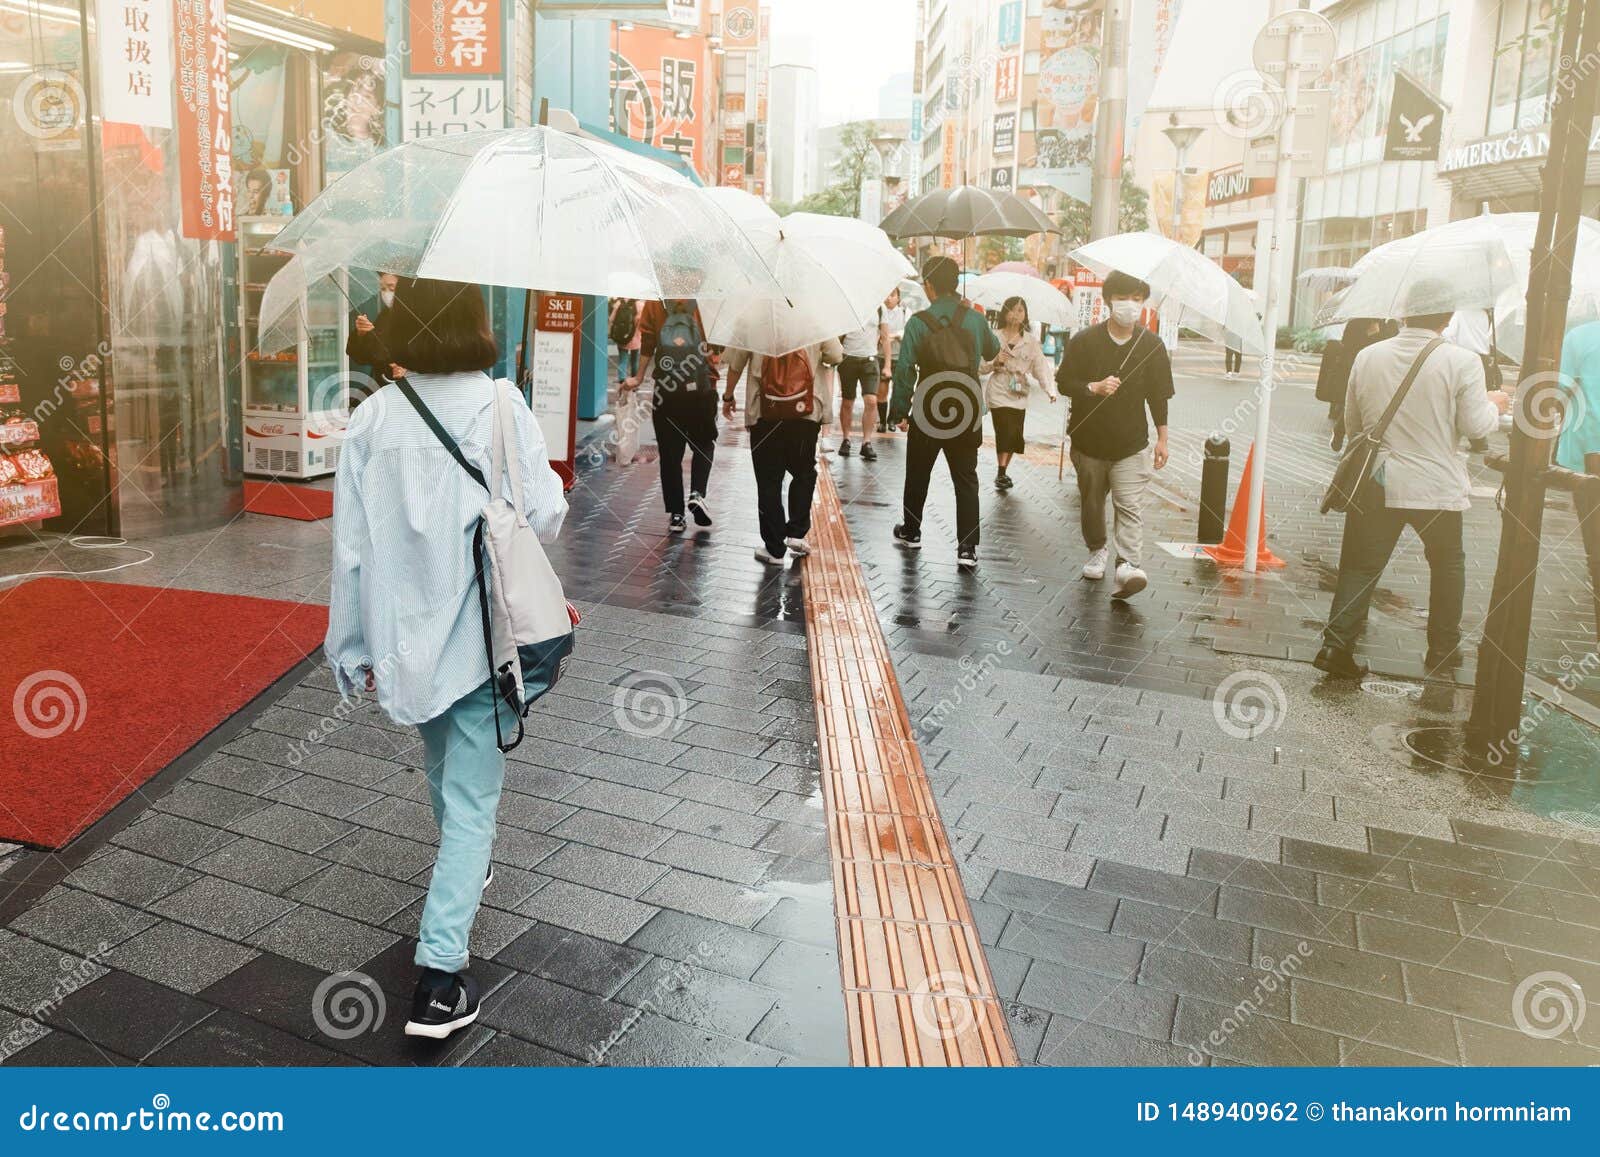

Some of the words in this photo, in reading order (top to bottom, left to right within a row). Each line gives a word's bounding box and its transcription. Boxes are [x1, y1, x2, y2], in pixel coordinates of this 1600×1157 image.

[124, 0, 154, 97] 取扱店
[408, 86, 502, 115] ネイル
[1443, 131, 1550, 162] AMERICAN
